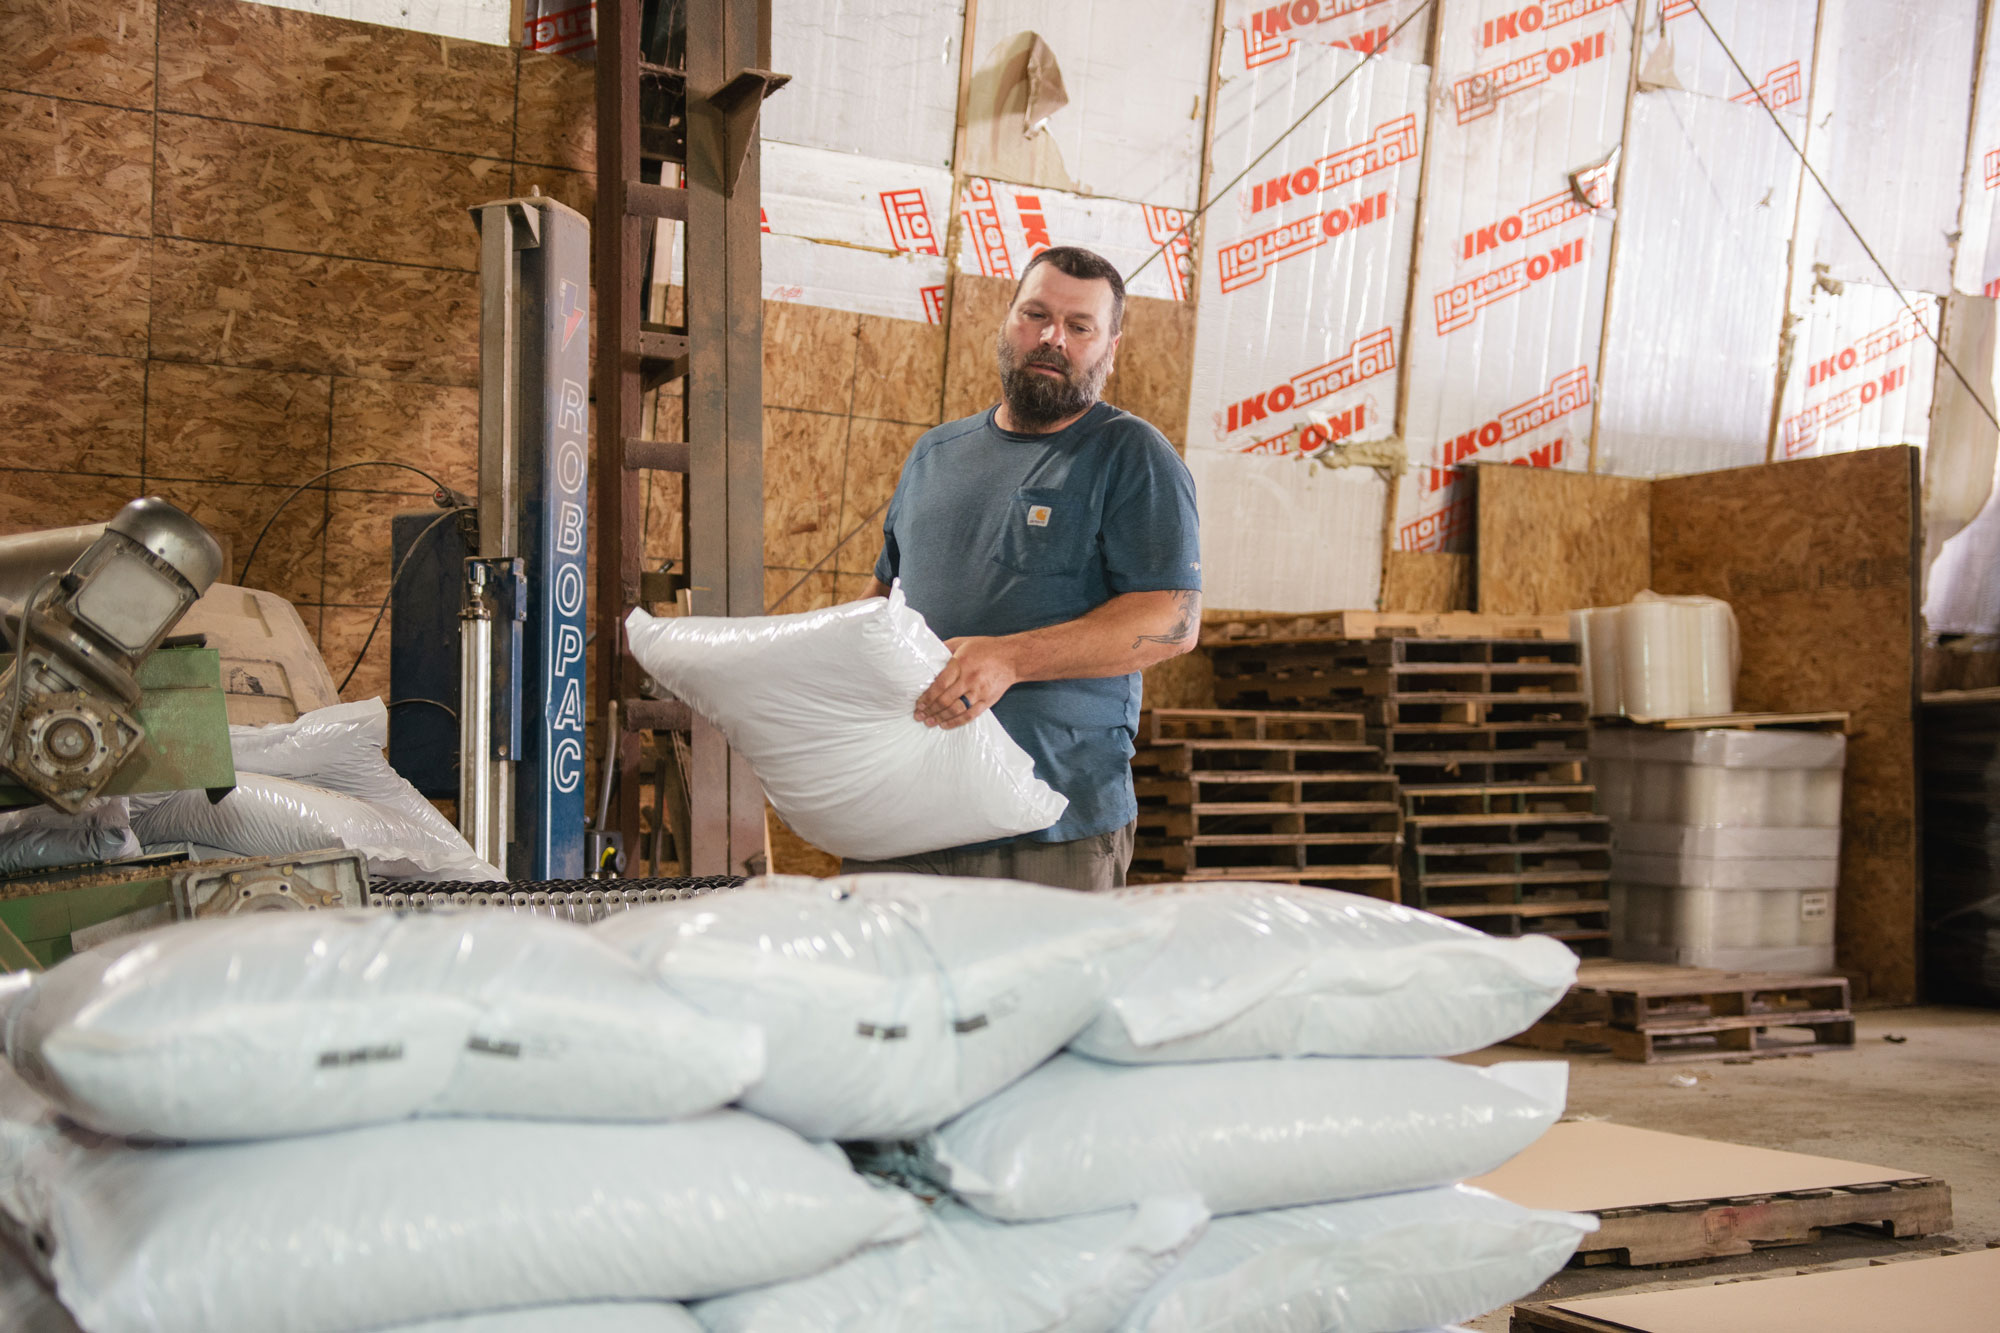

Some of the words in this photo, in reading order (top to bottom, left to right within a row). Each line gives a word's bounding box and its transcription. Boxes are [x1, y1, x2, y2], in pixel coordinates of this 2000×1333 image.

[1252, 0, 1320, 38] IKO
[1326, 25, 1389, 54] IK
[1484, 5, 1543, 48] IKO
[1547, 32, 1604, 74] IKO
[1252, 167, 1320, 214] IKO
[1315, 112, 1419, 193] Enerfoil
[1015, 195, 1052, 260] IK
[1322, 192, 1387, 237] IKO
[1218, 211, 1328, 294] Enerfoil
[1464, 216, 1523, 260] IKO
[1526, 238, 1583, 281] IKO
[1434, 258, 1530, 336] Enerfoil
[1227, 384, 1295, 433] IKO
[1290, 326, 1396, 409] Enerfoil
[1809, 348, 1857, 387] IKO
[1860, 365, 1905, 404] IKO
[1300, 404, 1365, 451] IKO
[1444, 421, 1503, 467] IKO
[1498, 365, 1591, 443] Enerfoil
[1503, 438, 1563, 468] IK
[553, 378, 585, 793] ROBOPAC
